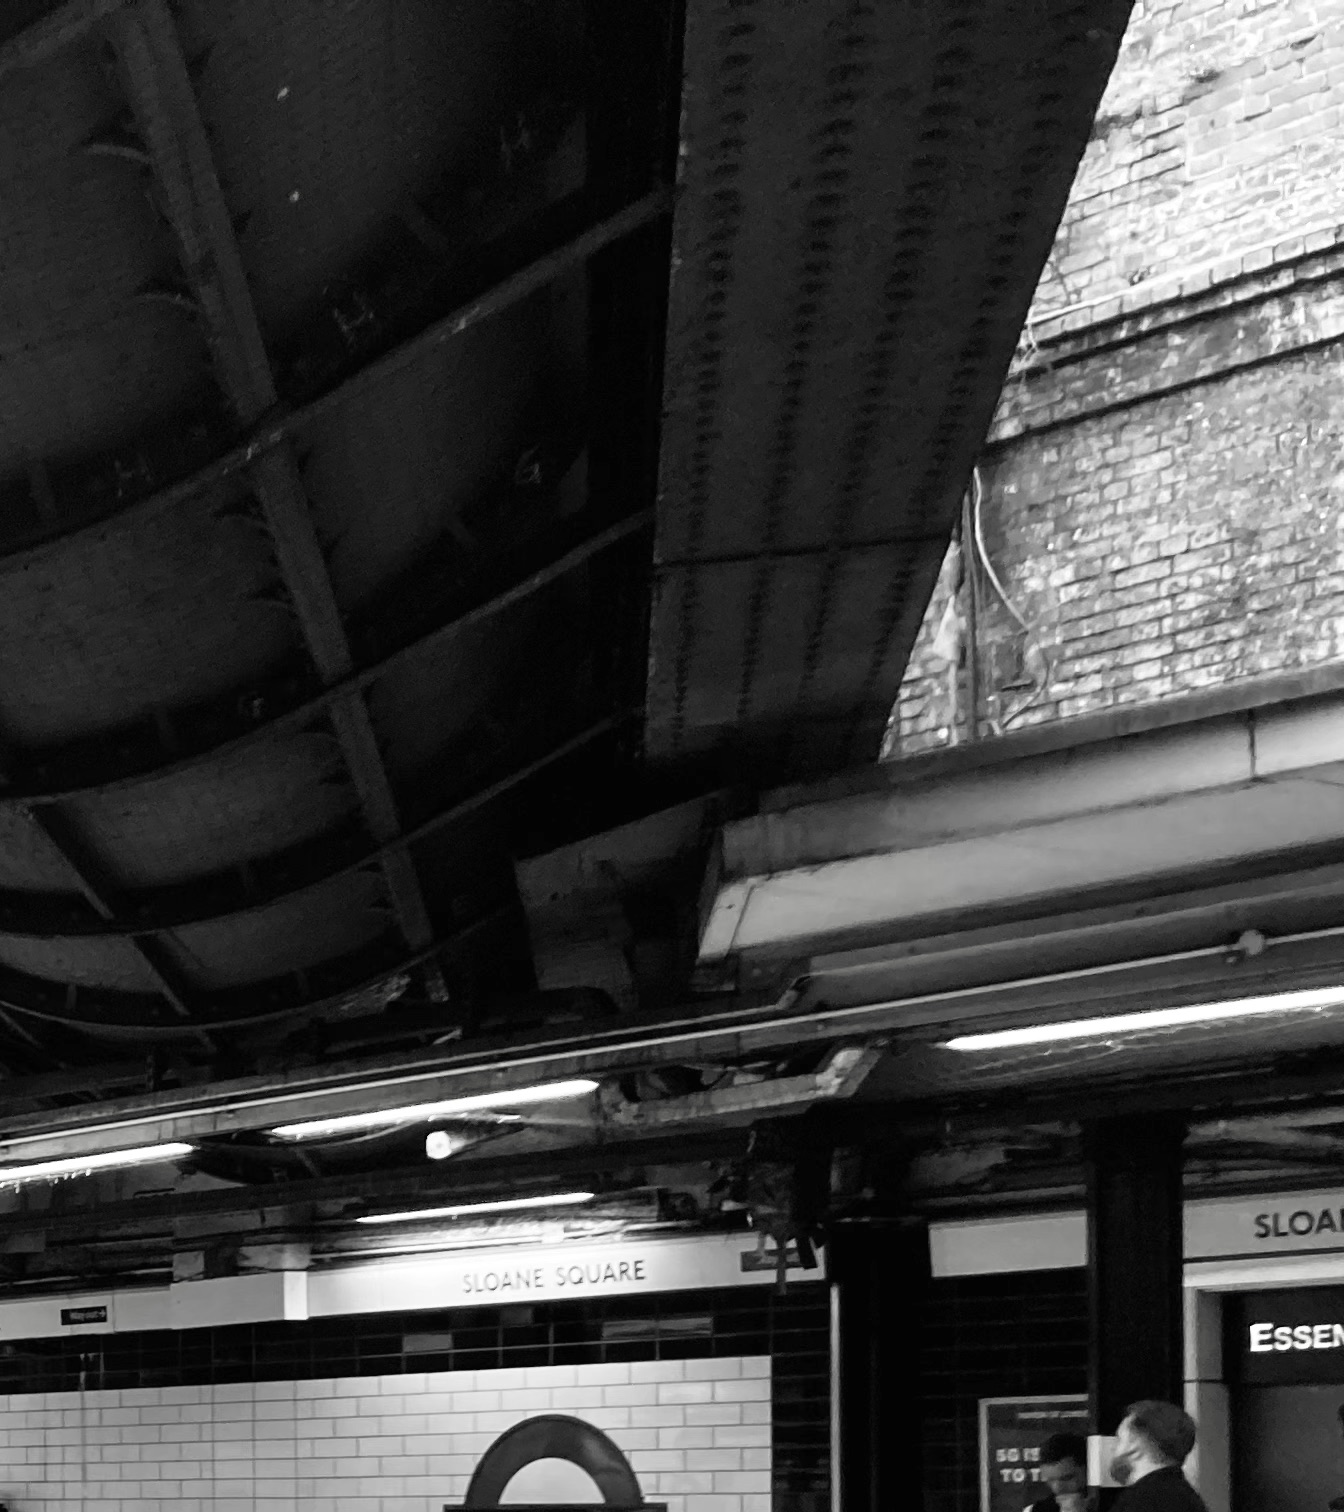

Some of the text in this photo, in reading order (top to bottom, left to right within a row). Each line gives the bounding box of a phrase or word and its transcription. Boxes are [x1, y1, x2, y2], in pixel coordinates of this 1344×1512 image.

[1253, 1208, 1344, 1239] SLOA
[463, 1259, 646, 1294] SLOANE SQUARE
